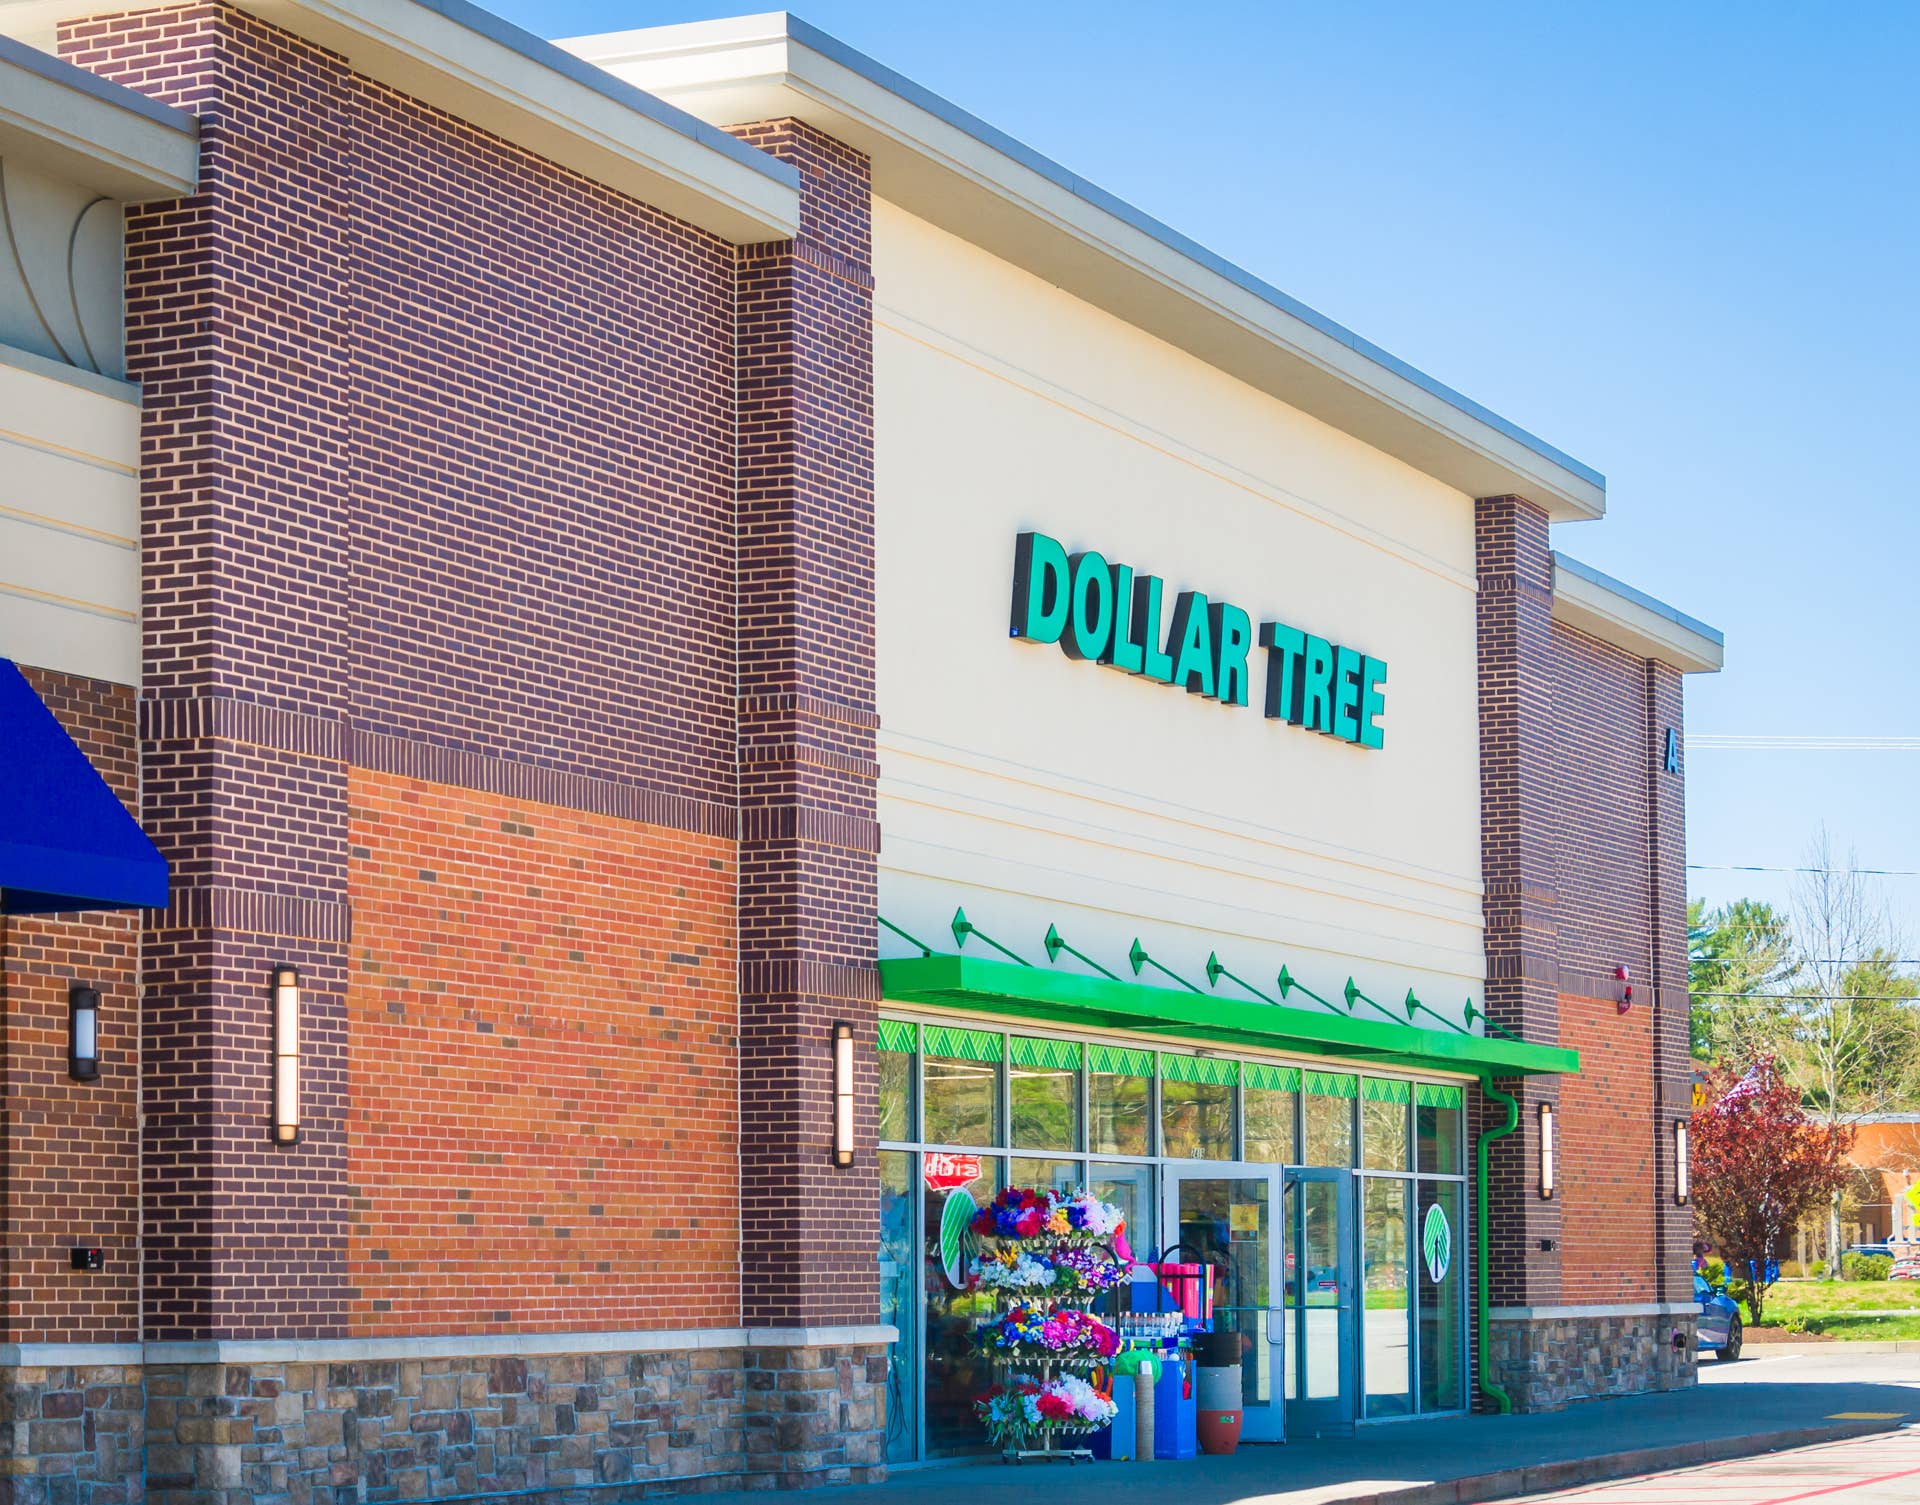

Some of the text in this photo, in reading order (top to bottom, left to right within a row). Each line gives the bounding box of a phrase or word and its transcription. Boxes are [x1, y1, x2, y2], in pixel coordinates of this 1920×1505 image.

[1010, 532, 1388, 750] DOLLAR TREE
[1665, 728, 1679, 774] A
